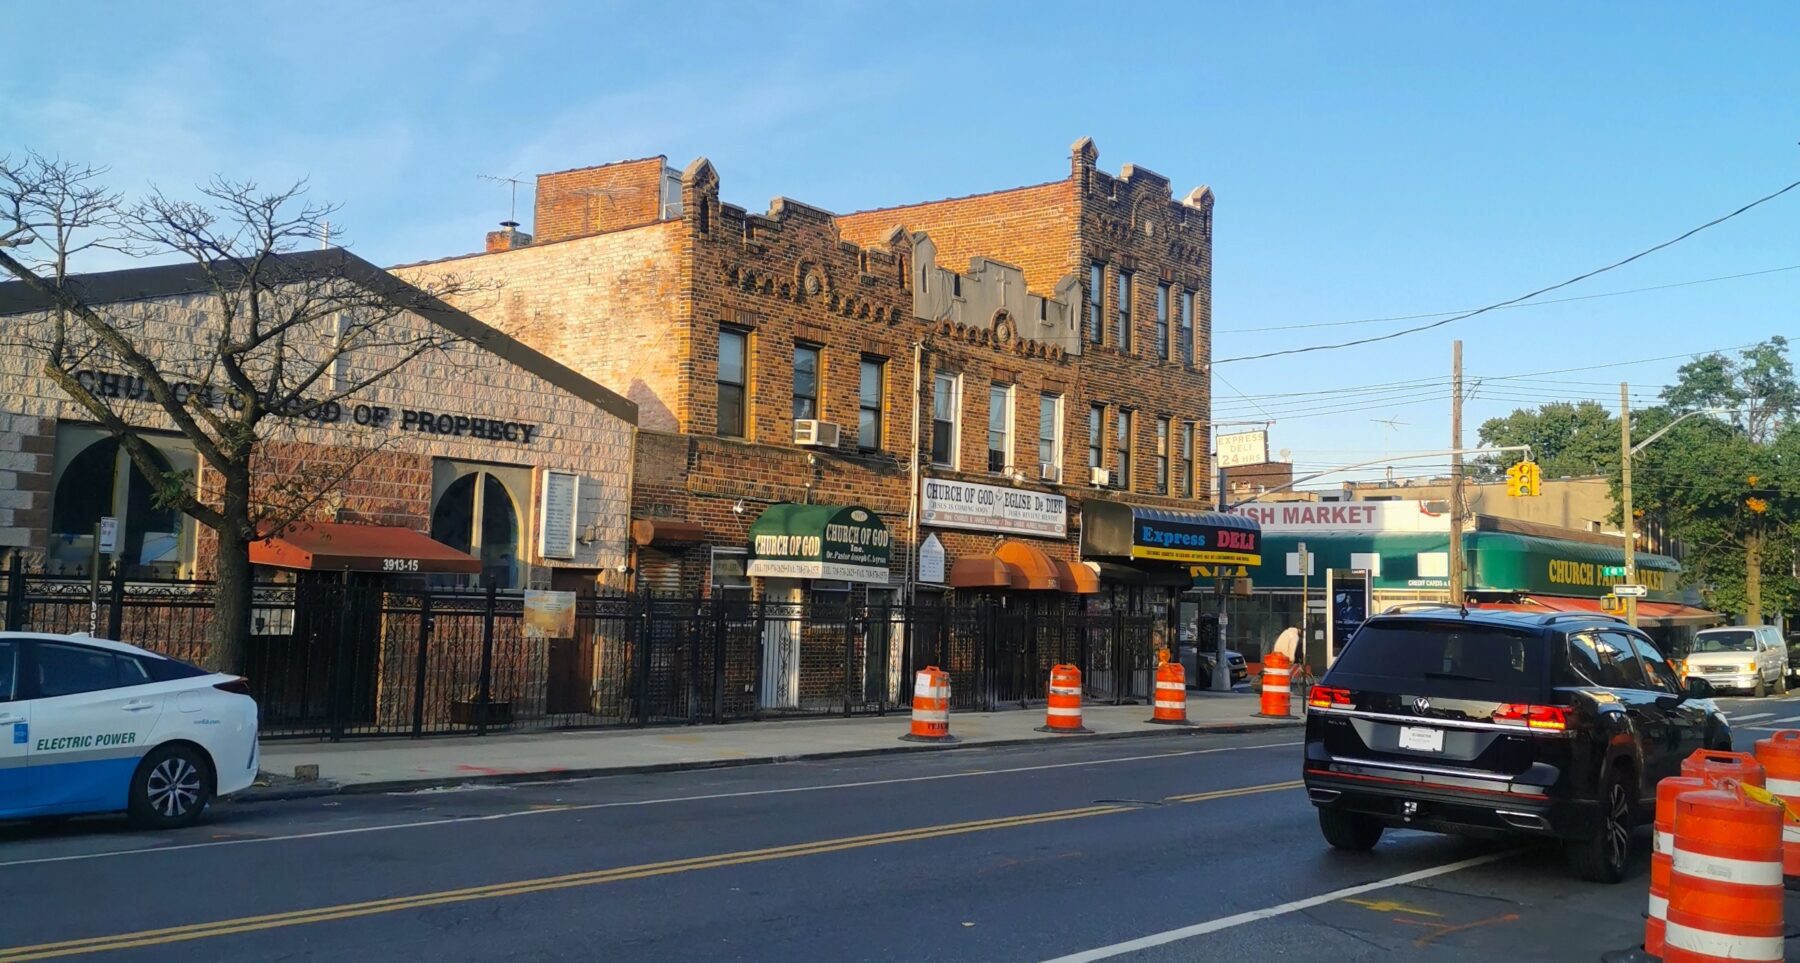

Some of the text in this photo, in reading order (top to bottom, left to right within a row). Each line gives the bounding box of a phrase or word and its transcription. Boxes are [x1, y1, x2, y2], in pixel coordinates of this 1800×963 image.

[353, 404, 390, 428] OF
[400, 409, 536, 445] PROPHECY
[1218, 432, 1263, 446] EXPRESS
[1230, 444, 1252, 453] DELI
[1222, 454, 1261, 466] 24 HRS
[926, 482, 994, 506] CHURCH OF GOD
[1004, 492, 1064, 514] EGLISE De DIEU
[1283, 505, 1377, 524] MARKET
[826, 523, 889, 547] CHURCH OF GOD
[1142, 526, 1255, 551] Express DELI
[754, 534, 820, 557] CHURCH OF GOD
[850, 544, 864, 553] Inc.
[382, 558, 419, 571] 3913-15
[1549, 559, 1594, 586] CHURCH
[1634, 568, 1665, 592] ARKET
[37, 732, 136, 751] ELECTRIC POWER
